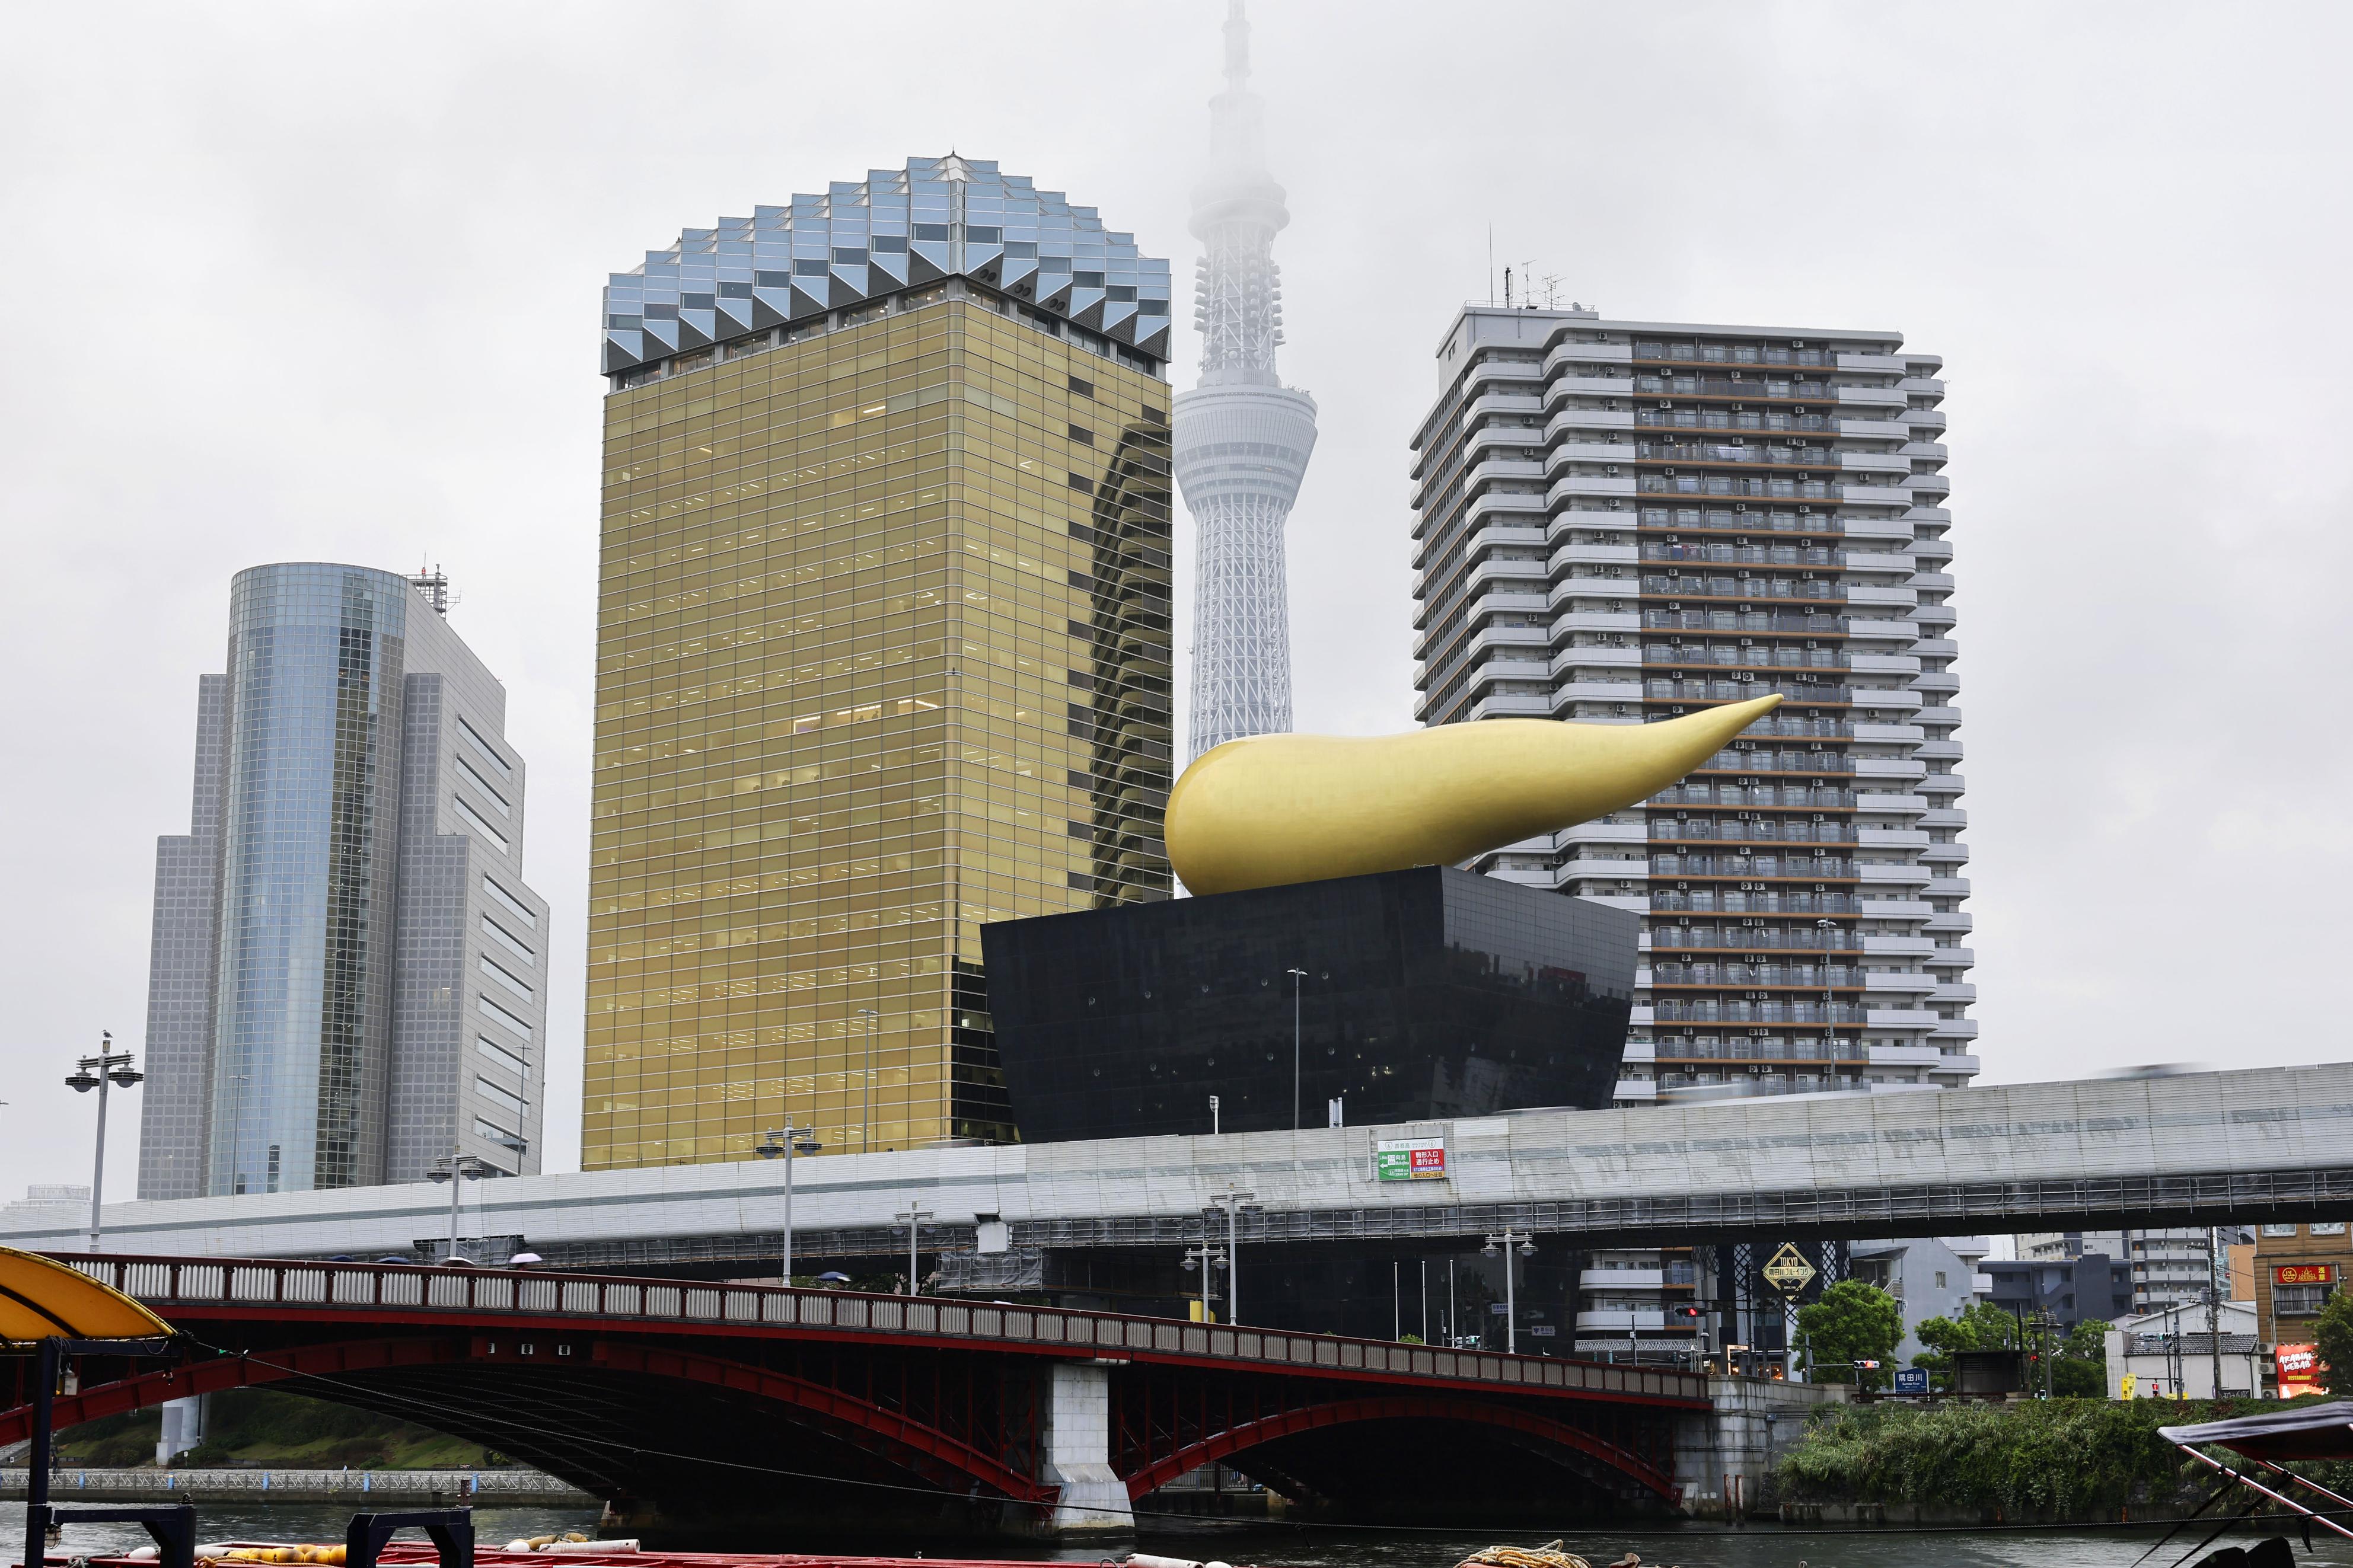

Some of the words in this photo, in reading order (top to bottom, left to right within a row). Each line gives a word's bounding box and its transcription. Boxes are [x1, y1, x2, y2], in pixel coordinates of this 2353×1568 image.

[1780, 1257, 1798, 1266] TOKYO
[1769, 1268, 1808, 1276] 隅田川ブルーイング
[2318, 1267, 2326, 1280] 浅草
[2283, 1361, 2311, 1372] KEBAB
[1899, 1374, 1922, 1382] 隅田川
